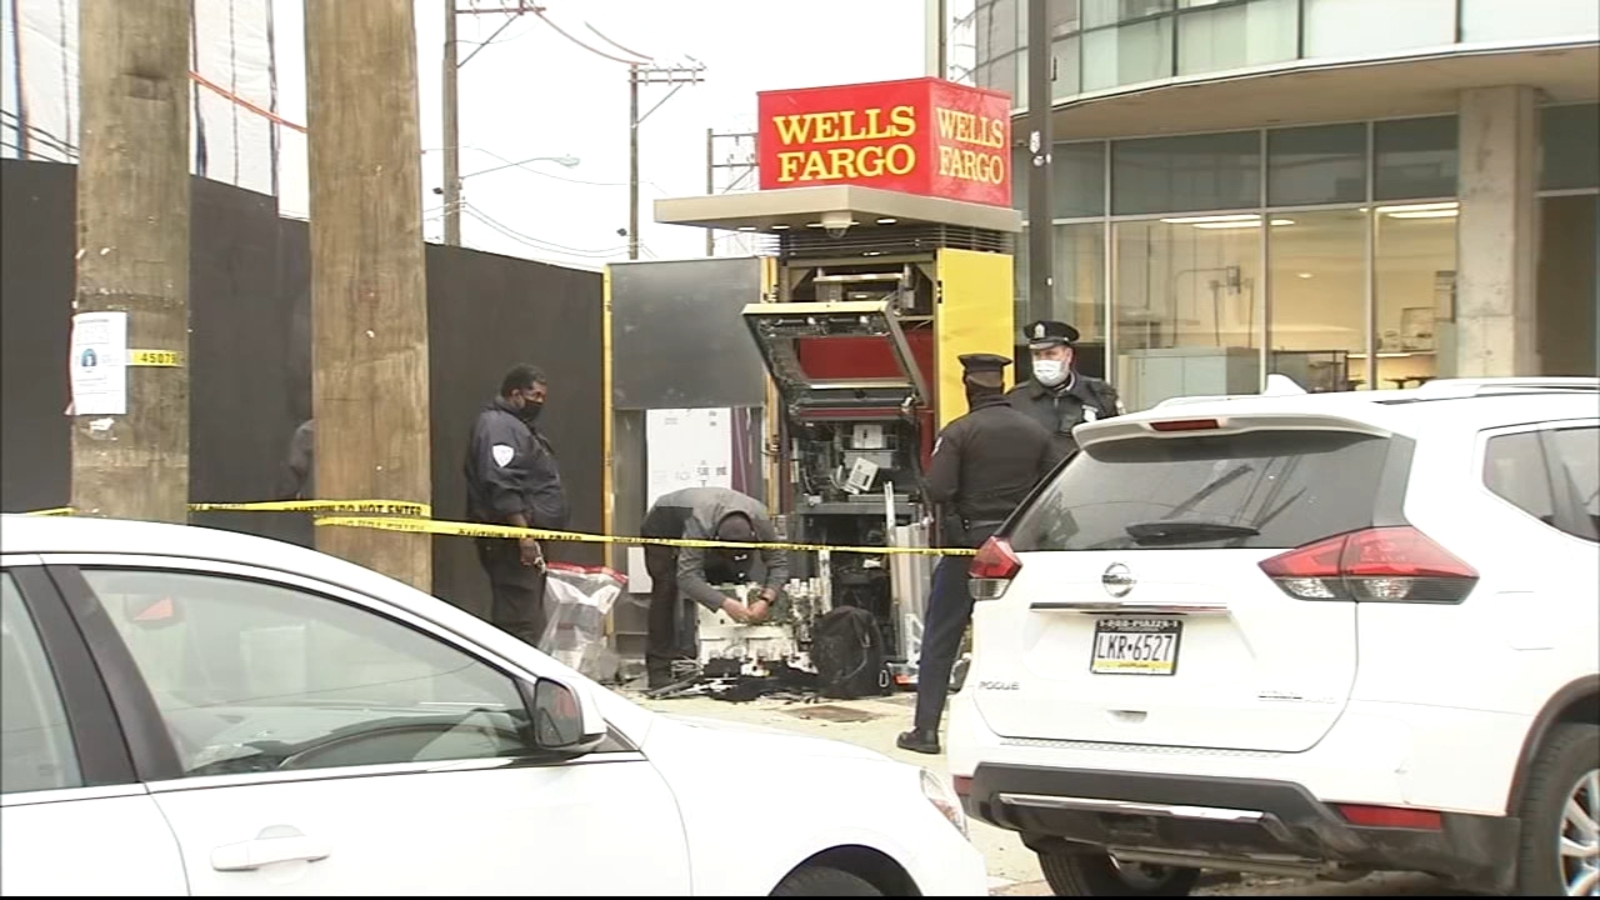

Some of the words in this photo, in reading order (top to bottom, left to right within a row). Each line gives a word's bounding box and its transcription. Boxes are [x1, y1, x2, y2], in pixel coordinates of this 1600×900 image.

[773, 105, 916, 145] WELLS
[937, 107, 1003, 148] WELLS
[777, 144, 915, 182] FARGO
[939, 146, 1003, 184] FARGO
[360, 504, 383, 514] NOT
[387, 504, 421, 516] ENTER
